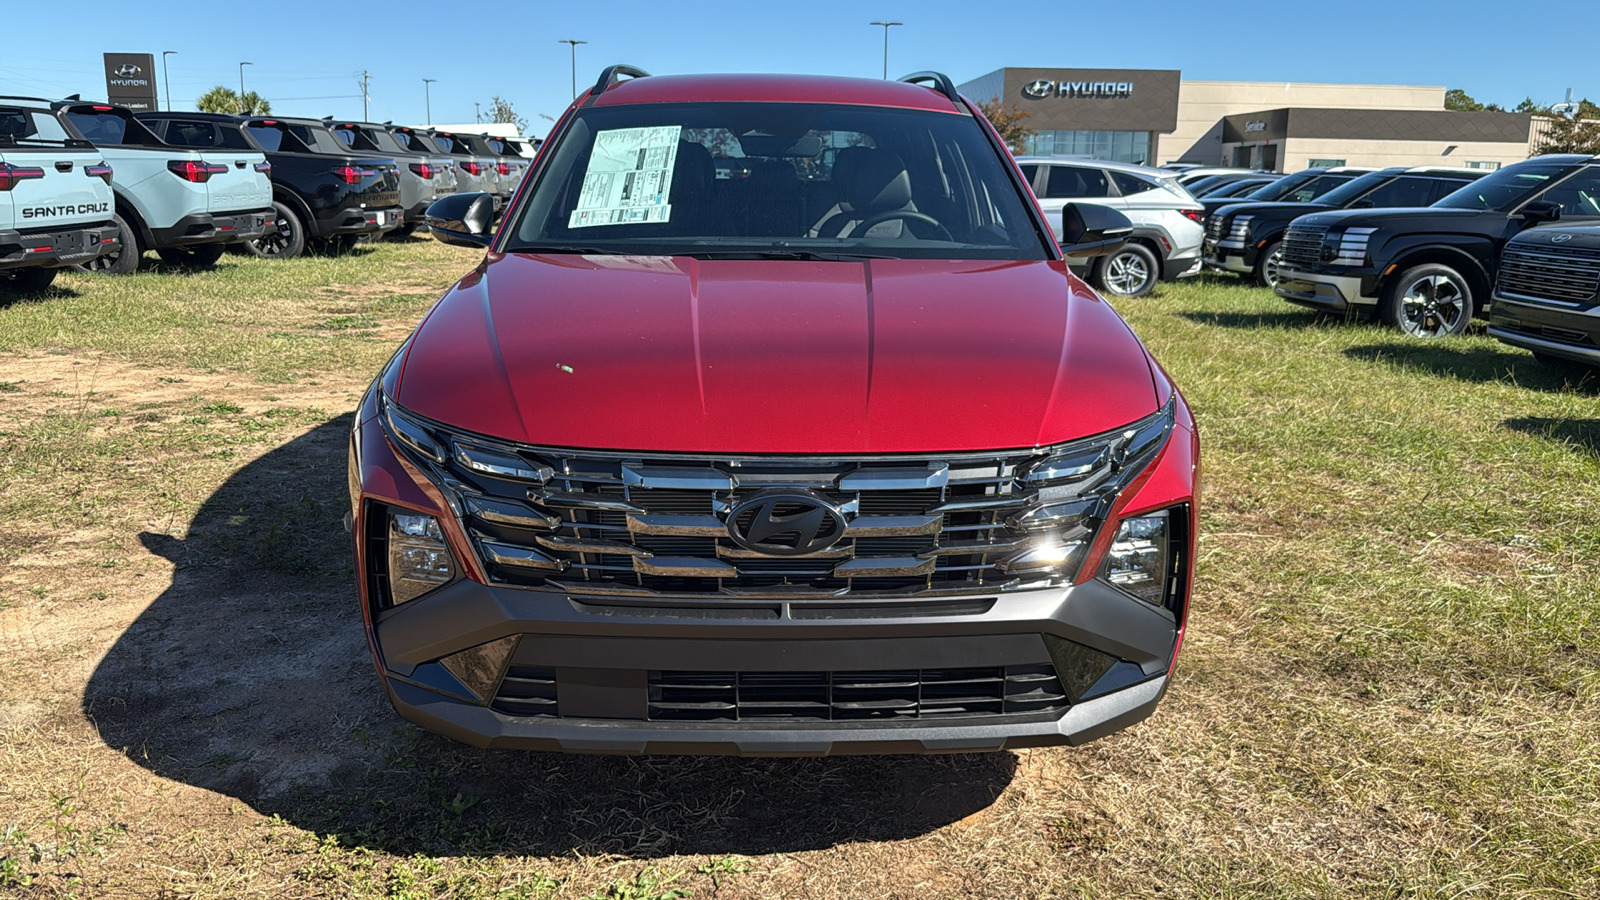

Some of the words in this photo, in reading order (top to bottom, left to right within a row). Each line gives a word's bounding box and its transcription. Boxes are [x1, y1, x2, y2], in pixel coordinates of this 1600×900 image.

[110, 79, 148, 87] HYUNDAI
[1059, 82, 1133, 95] HYUNDAI
[1245, 120, 1265, 133] Service
[22, 204, 75, 218] SANTA
[78, 202, 108, 214] CRUZ
